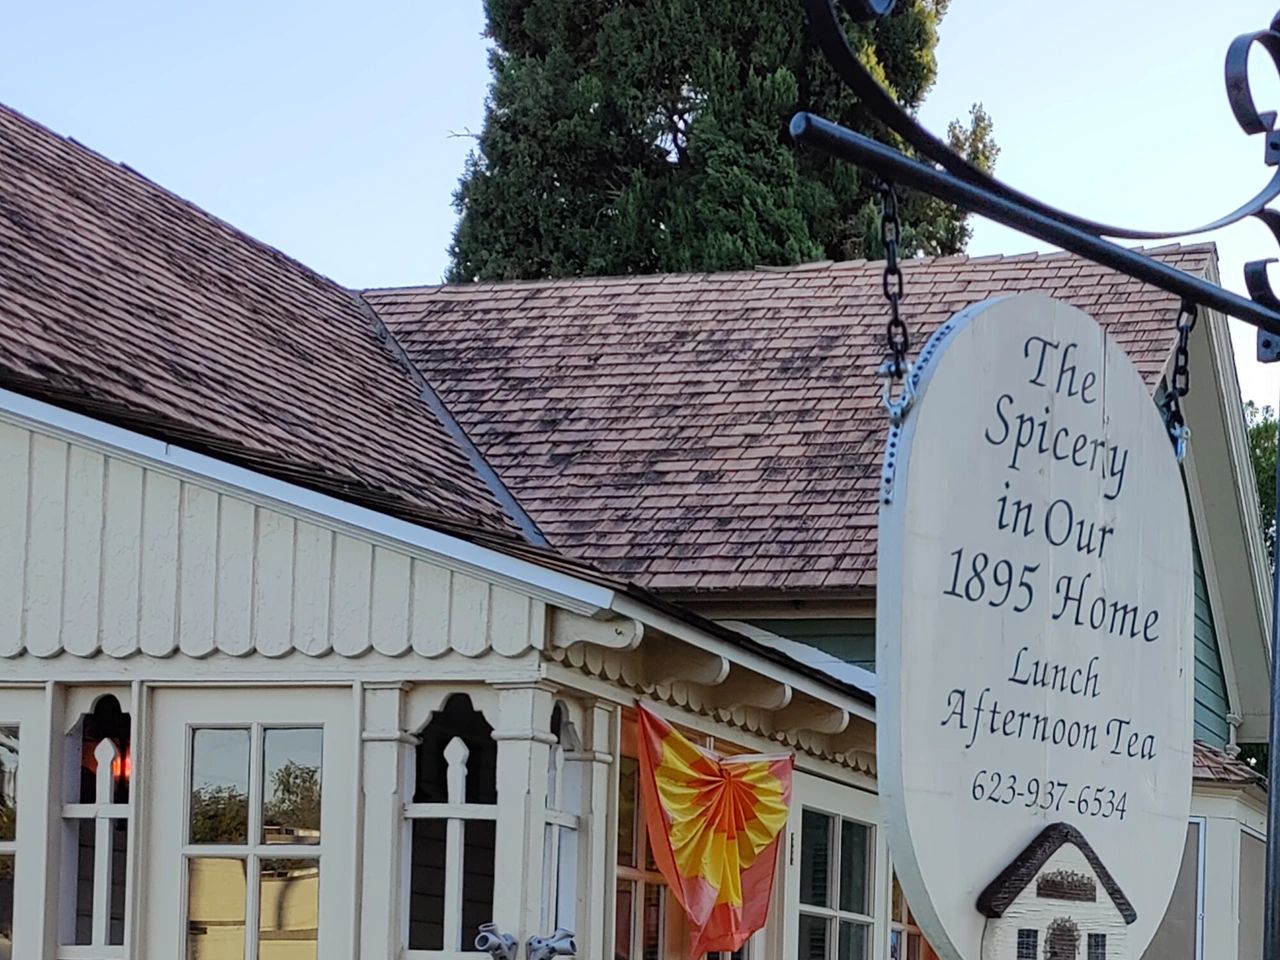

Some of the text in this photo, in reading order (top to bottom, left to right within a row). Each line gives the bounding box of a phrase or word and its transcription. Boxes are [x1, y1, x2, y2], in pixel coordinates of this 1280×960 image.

[1024, 336, 1096, 404] The
[985, 394, 1128, 500] Spicery
[997, 482, 1114, 558] in Our
[943, 547, 1159, 640] 1895 Home
[1008, 647, 1101, 698] Lunch
[941, 689, 1157, 760] Afternoon Tea
[971, 770, 1128, 821] 623-937-6534
